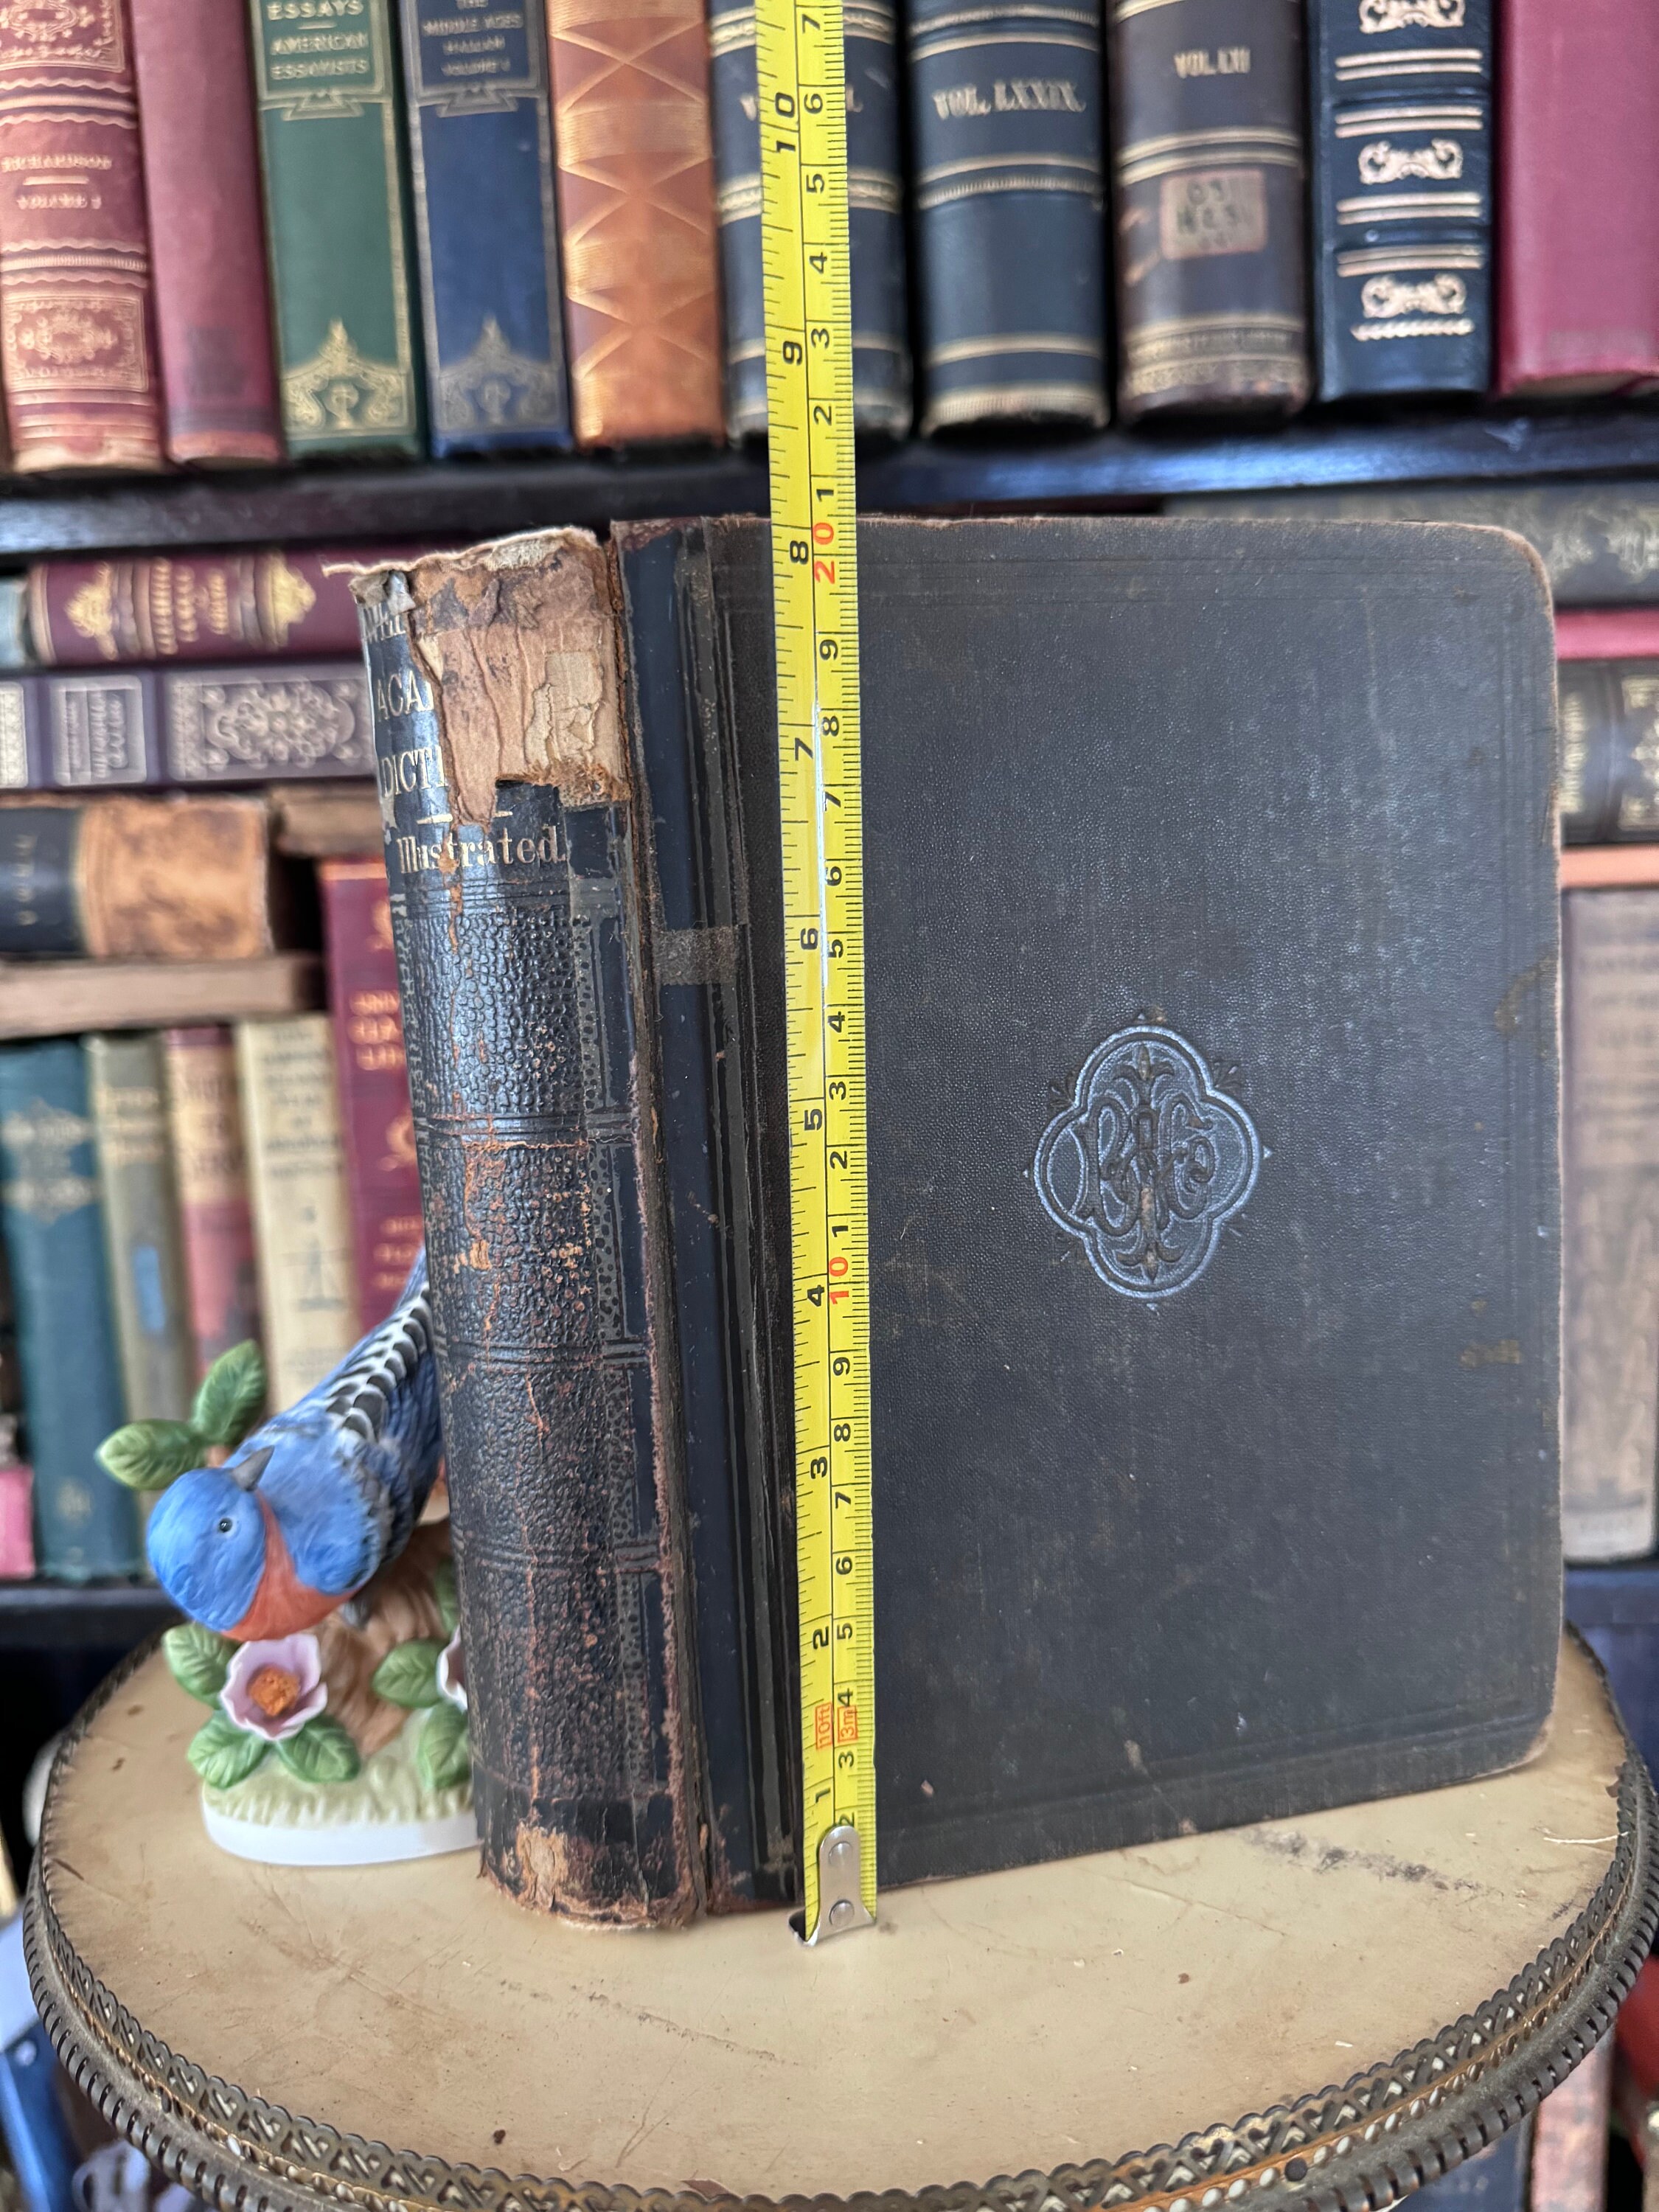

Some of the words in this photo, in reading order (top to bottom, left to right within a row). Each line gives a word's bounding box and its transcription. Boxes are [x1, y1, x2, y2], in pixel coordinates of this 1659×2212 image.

[268, 0, 364, 21] ESSAYS
[801, 13, 821, 34] 7
[804, 93, 824, 114] 6
[775, 91, 796, 153] 10
[806, 173, 824, 194] 5
[810, 251, 827, 274] 4
[811, 328, 830, 349] 3
[782, 340, 803, 366] 9
[813, 406, 832, 425] 2
[816, 489, 834, 502] 1
[789, 540, 809, 565] 8
[813, 522, 835, 584] 20
[819, 639, 838, 661] 9
[821, 715, 839, 737] 8
[795, 737, 813, 761] 7
[824, 791, 841, 812] 7
[824, 866, 842, 886] 6
[800, 928, 818, 950] 6
[827, 939, 844, 959] 5
[827, 1011, 846, 1033] 4
[829, 1081, 846, 1101] 3
[804, 1108, 822, 1131] 5
[830, 1151, 848, 1169] 2
[832, 1225, 848, 1237] 1
[829, 1256, 849, 1304] 10
[807, 1284, 825, 1307] 4
[833, 1357, 851, 1377] 9
[834, 1423, 852, 1442] 8
[810, 1456, 828, 1479] 3
[835, 1492, 852, 1509] 7
[835, 1556, 853, 1575] 6
[813, 1626, 830, 1650] 2
[836, 1623, 853, 1640] 5
[838, 1688, 854, 1707] 4
[838, 1751, 855, 1768] 3
[815, 1787, 832, 1804] 1
